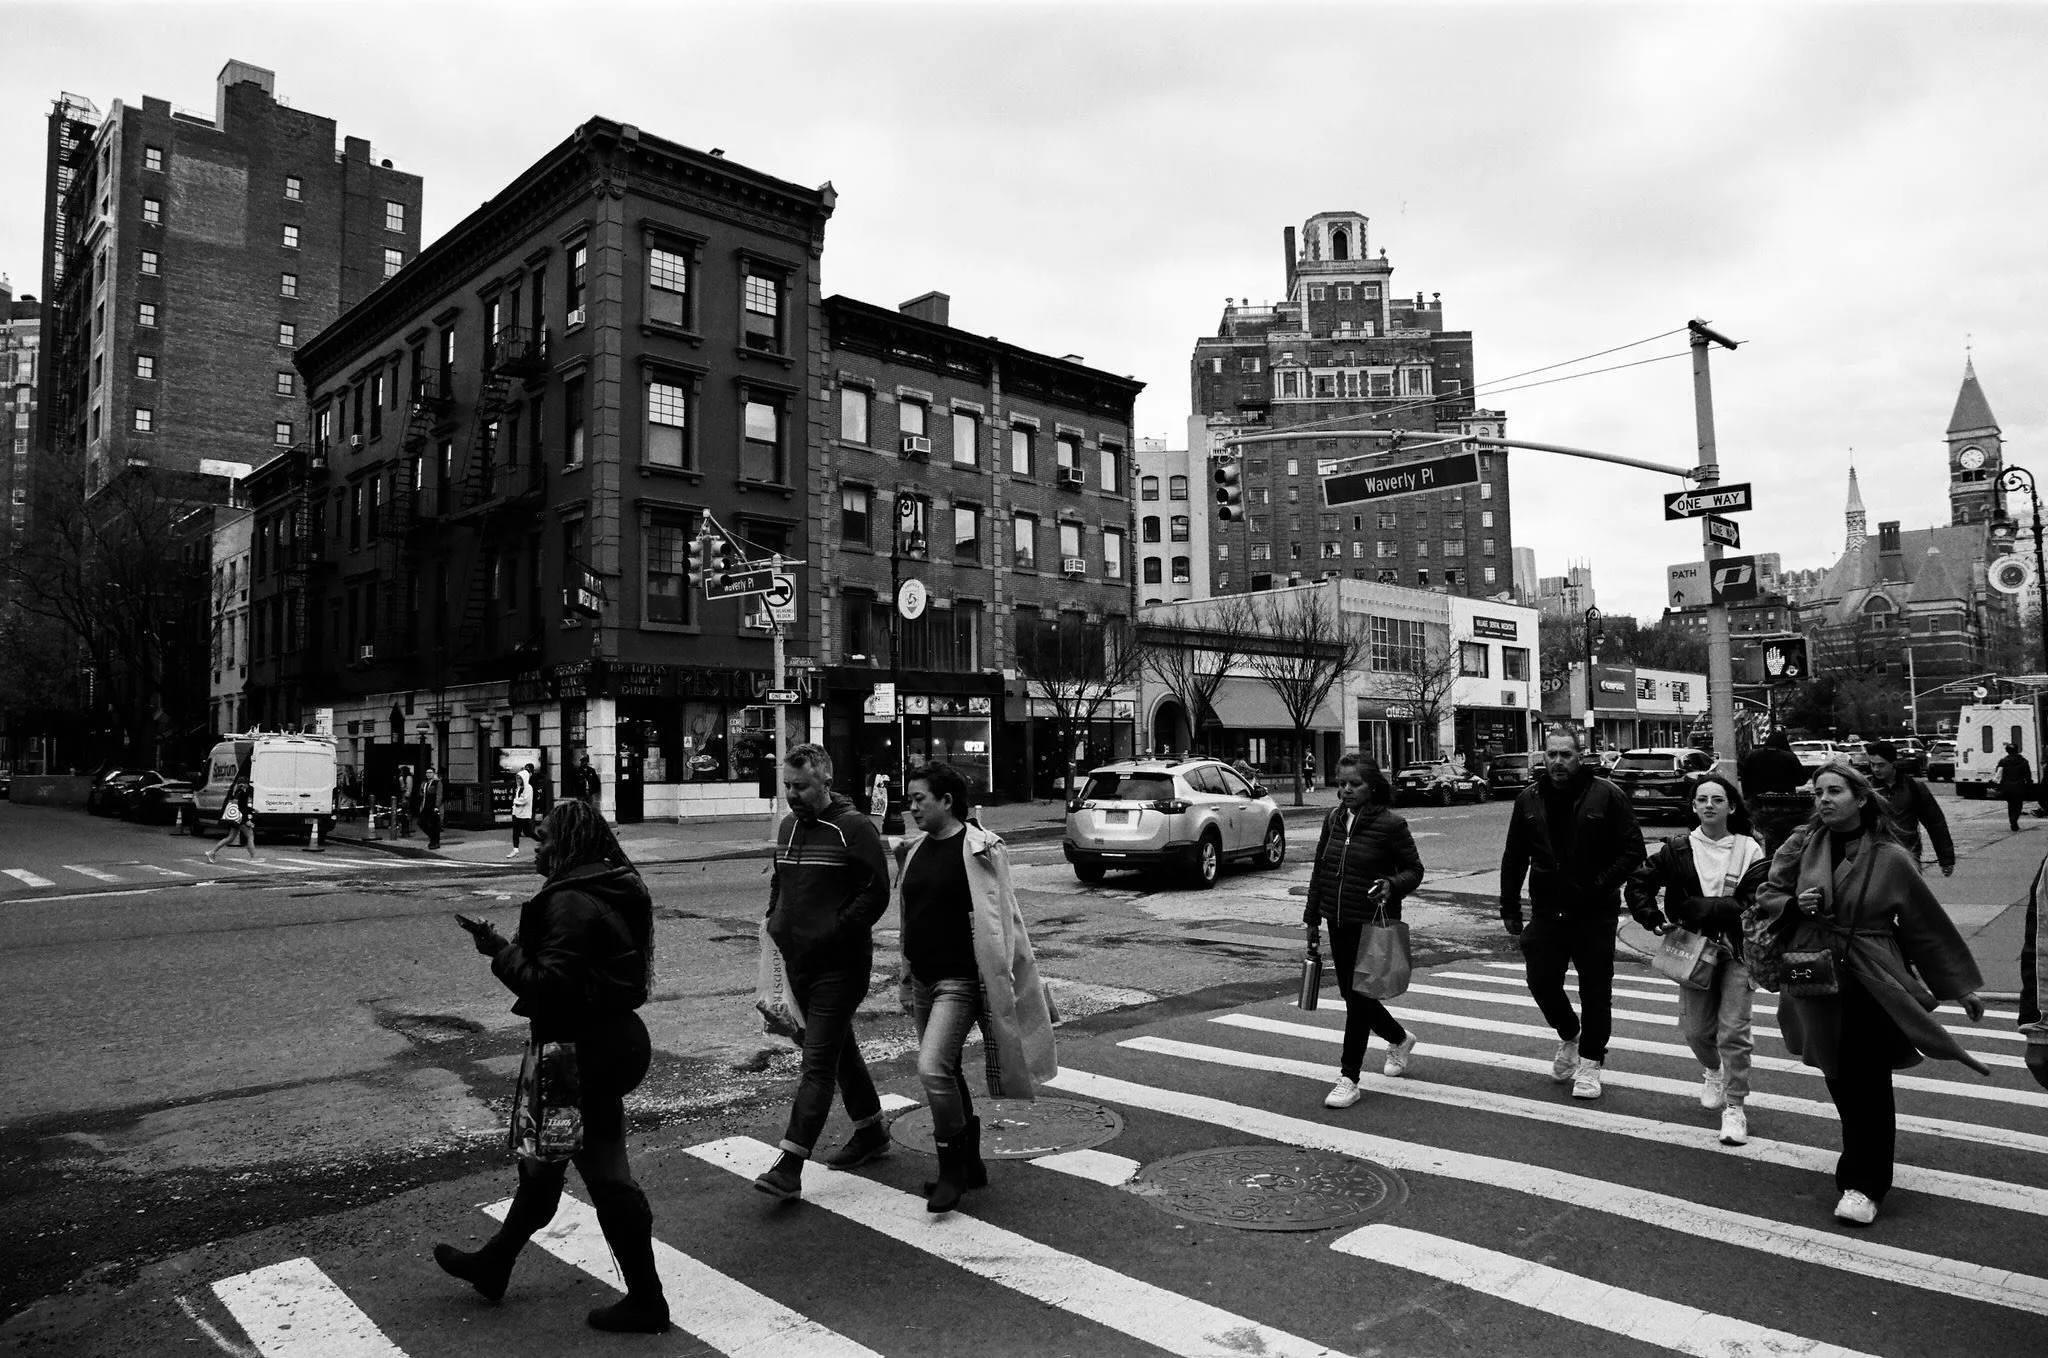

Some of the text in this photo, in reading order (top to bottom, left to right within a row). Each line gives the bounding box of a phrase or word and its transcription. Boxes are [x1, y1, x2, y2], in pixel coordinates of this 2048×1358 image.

[1364, 467, 1435, 494] Waverly Pl
[1677, 492, 1740, 511] ONE WAY
[1671, 568, 1697, 580] PATH
[747, 577, 755, 589] Pl
